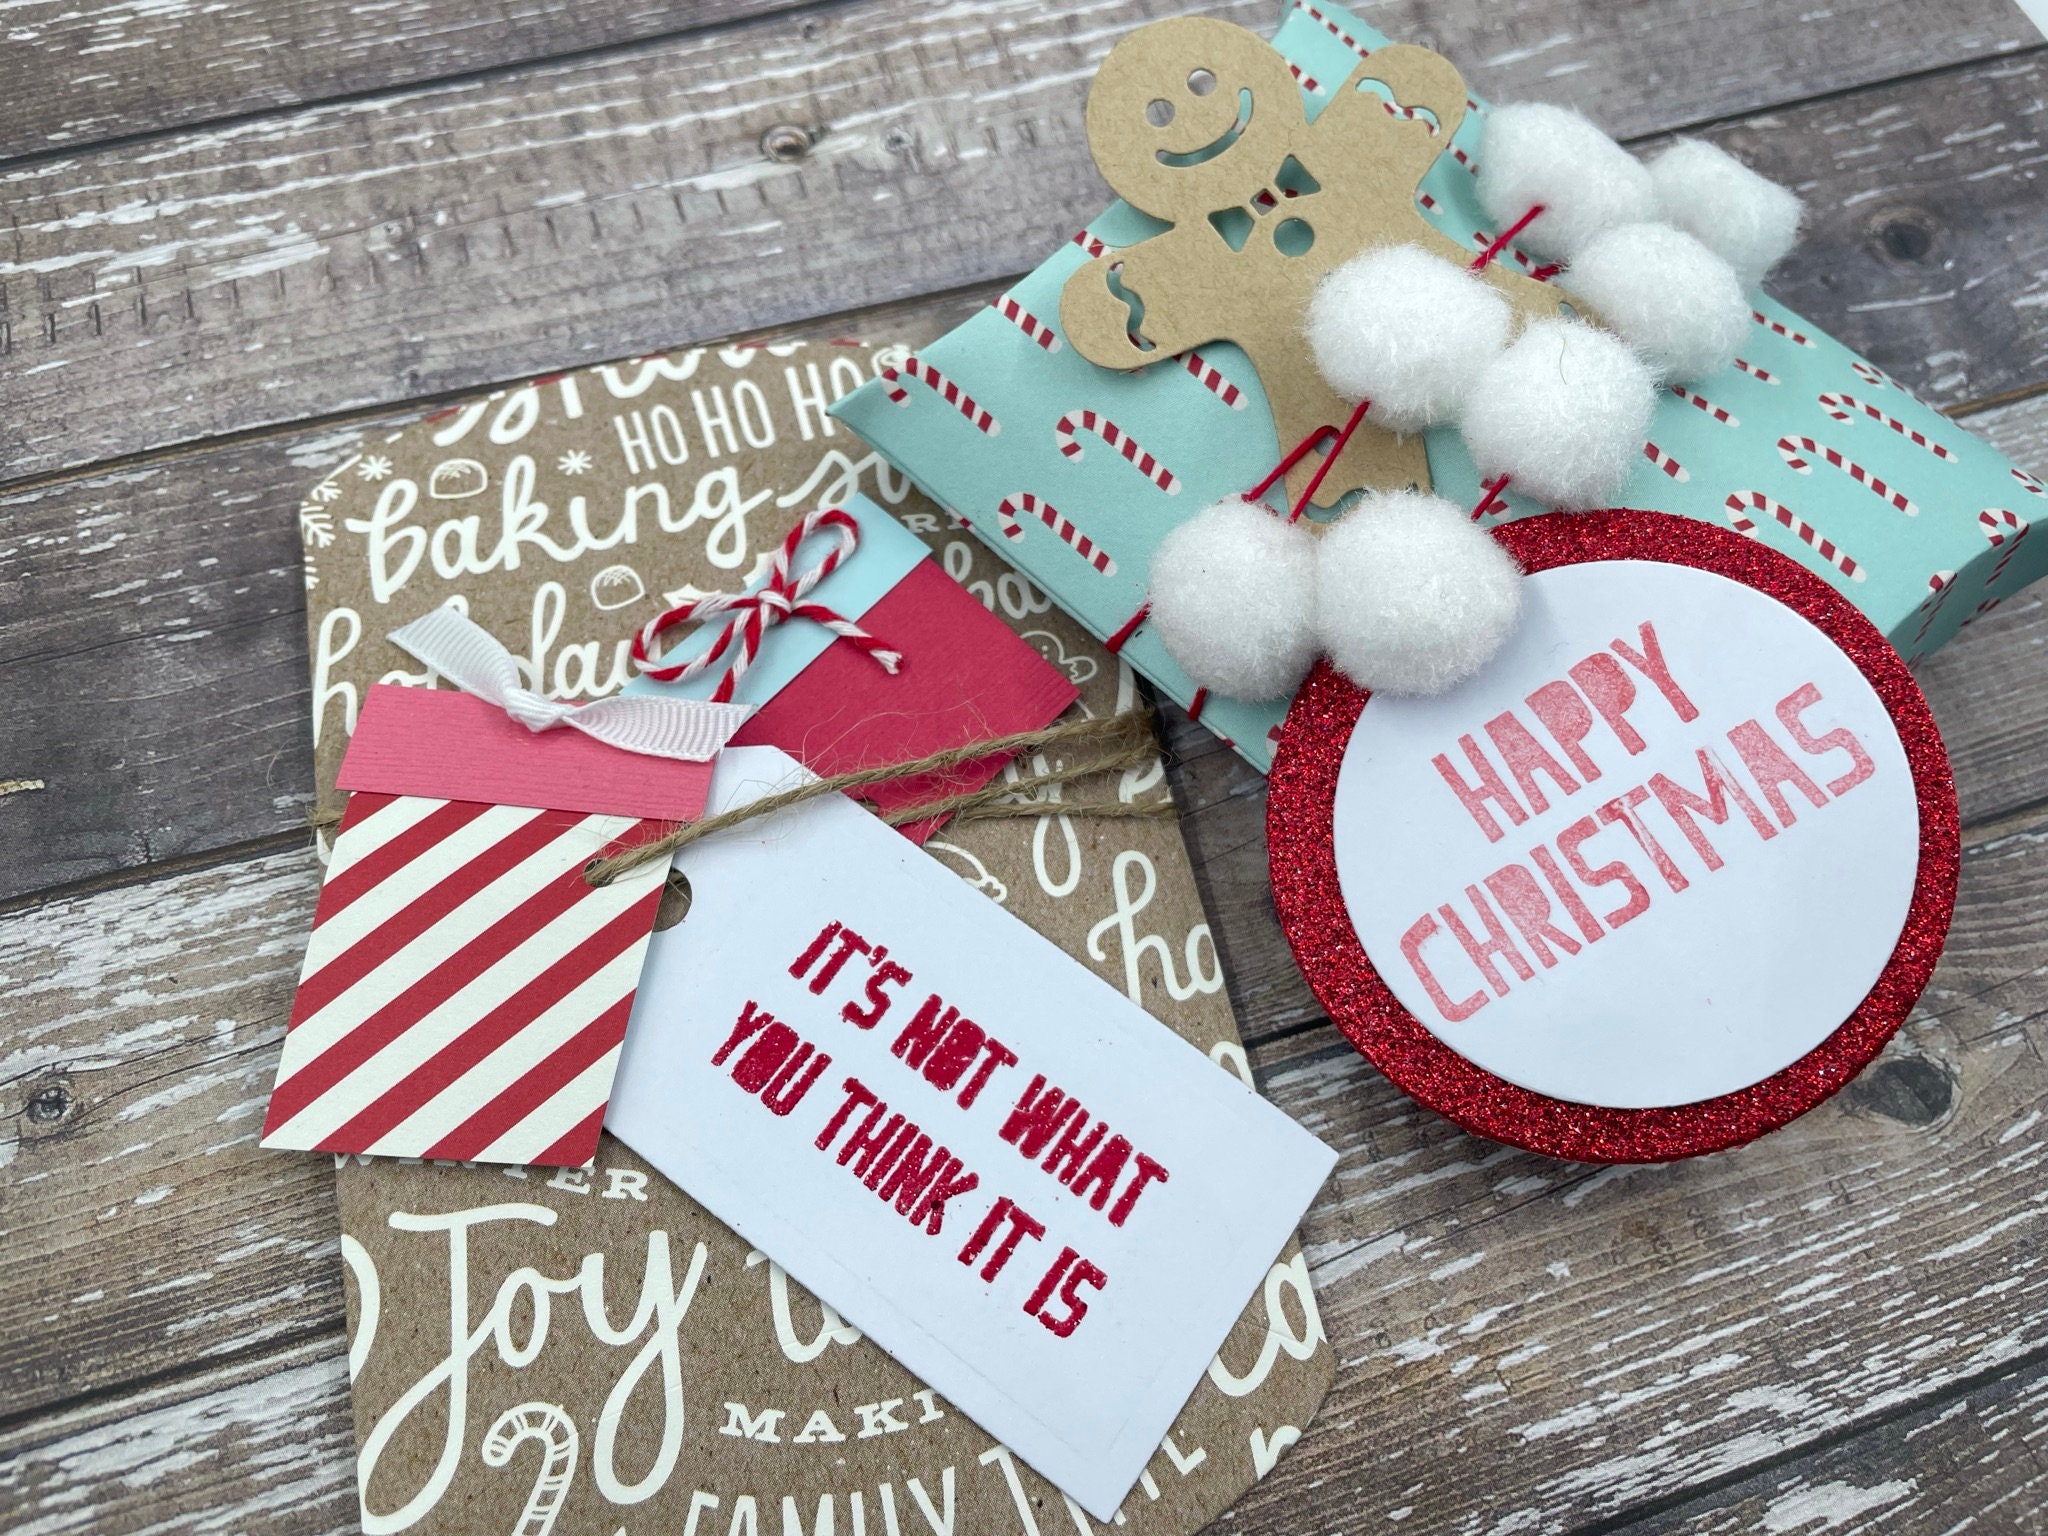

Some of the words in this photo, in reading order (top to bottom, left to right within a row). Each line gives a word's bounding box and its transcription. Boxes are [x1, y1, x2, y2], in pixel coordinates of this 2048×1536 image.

[345, 454, 773, 604] baking
[614, 404, 689, 474] HO
[691, 379, 776, 459] HO
[1399, 681, 1876, 1022] CHRISTMAS
[1431, 620, 1700, 844] HAPPY
[711, 999, 833, 1117] YOU
[814, 1077, 979, 1236] THINK
[957, 1196, 1046, 1284] IT
[1022, 1246, 1109, 1339] IS
[788, 920, 913, 1030] IT'S
[890, 993, 1019, 1111] NOT
[998, 1074, 1170, 1228] WHAT
[357, 1202, 708, 1535] Joy
